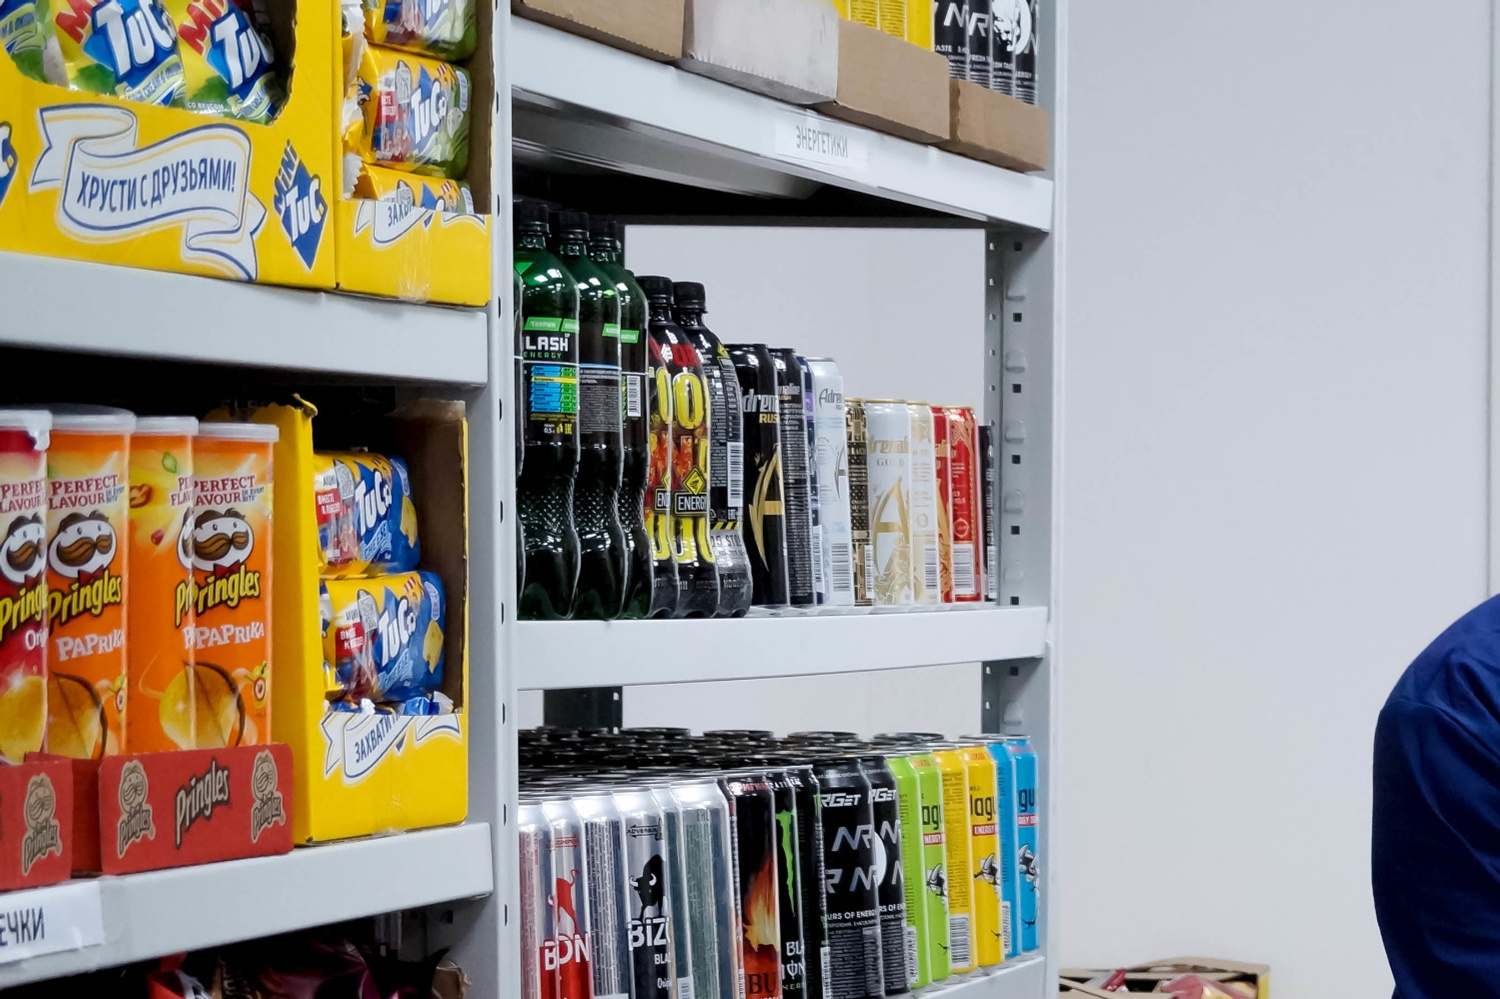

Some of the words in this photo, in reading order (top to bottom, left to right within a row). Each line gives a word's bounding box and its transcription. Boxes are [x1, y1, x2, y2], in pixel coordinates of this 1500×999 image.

[795, 125, 848, 158] ЭНЕРГЕТИКИ
[78, 167, 138, 213] ХРУСТИ
[151, 158, 236, 208] ДРУЗЬЯМИ!
[525, 336, 568, 352] LASH
[759, 414, 778, 424] RUS
[1, 477, 46, 498] PERFE
[51, 474, 119, 498] PERFECT
[194, 474, 256, 494] PERFECT
[0, 495, 43, 515] LAVOU
[49, 494, 106, 511] LAVOUR
[195, 491, 242, 507] AVOUR
[678, 495, 708, 511] ENERG
[48, 570, 123, 627] Pringles
[196, 566, 261, 617] Pringles
[199, 621, 265, 649] PAPRIKA
[175, 759, 230, 848] Pringles
[0, 907, 45, 946] ЕЧКИ
[654, 953, 671, 965] BLA
[748, 973, 776, 995] BU
